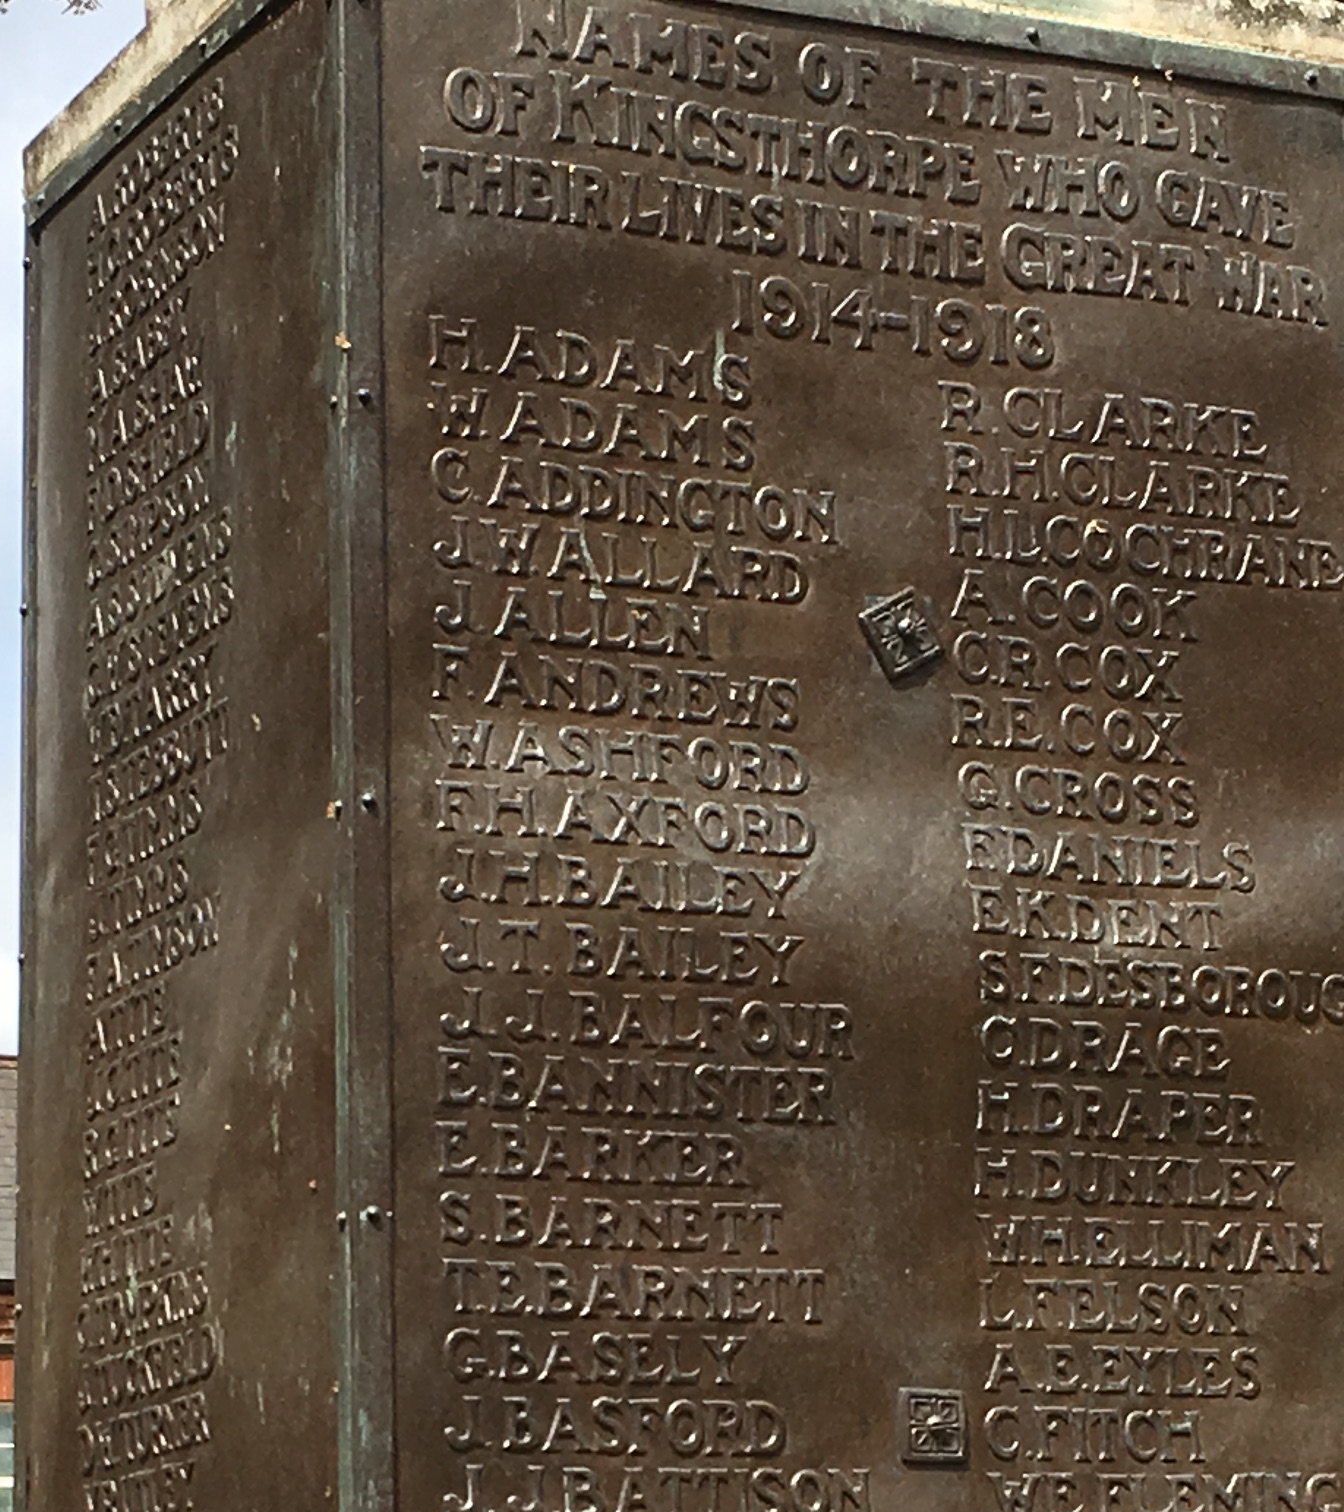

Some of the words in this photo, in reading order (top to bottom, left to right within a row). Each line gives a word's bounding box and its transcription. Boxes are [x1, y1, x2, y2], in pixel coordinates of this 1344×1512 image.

[444, 66, 534, 136] OF
[550, 70, 982, 203] KINGSTHORPE
[998, 149, 1140, 220] WHO
[1156, 175, 1296, 248] GAVE
[516, 4, 773, 93] NAMES
[796, 41, 881, 109] OF
[912, 56, 1053, 135] THE
[1074, 76, 1229, 161] MEN
[419, 145, 612, 231] THEIR
[622, 172, 787, 257] LIVES
[796, 201, 860, 268] IN
[870, 208, 987, 284] THE
[998, 222, 1208, 307] GREAT
[1204, 246, 1329, 327] WAR
[731, 268, 1057, 369] 1914-1918
